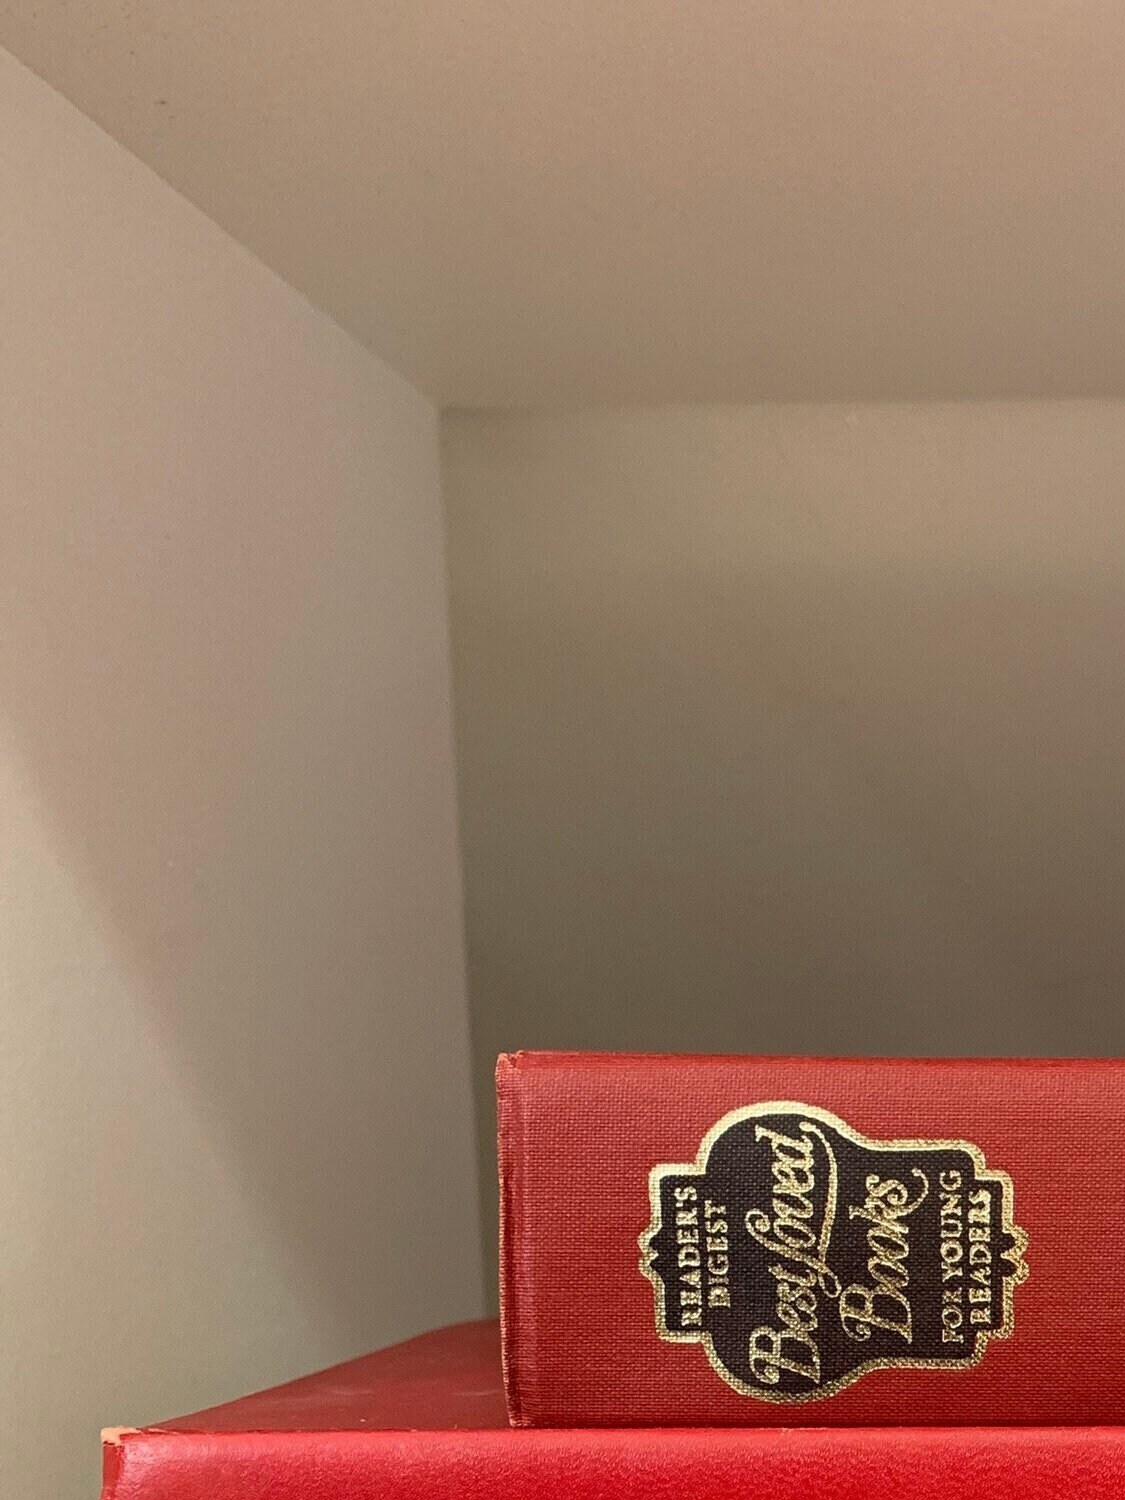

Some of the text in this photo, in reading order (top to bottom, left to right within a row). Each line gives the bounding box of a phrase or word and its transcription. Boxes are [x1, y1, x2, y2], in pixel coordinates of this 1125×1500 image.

[674, 1185, 703, 1327] READER'S
[704, 1200, 731, 1308] DIGEST
[748, 1263, 821, 1384] Best
[839, 1167, 930, 1344] Books
[937, 1169, 964, 1344] FOR YOUNG
[967, 1188, 992, 1325] READERS
